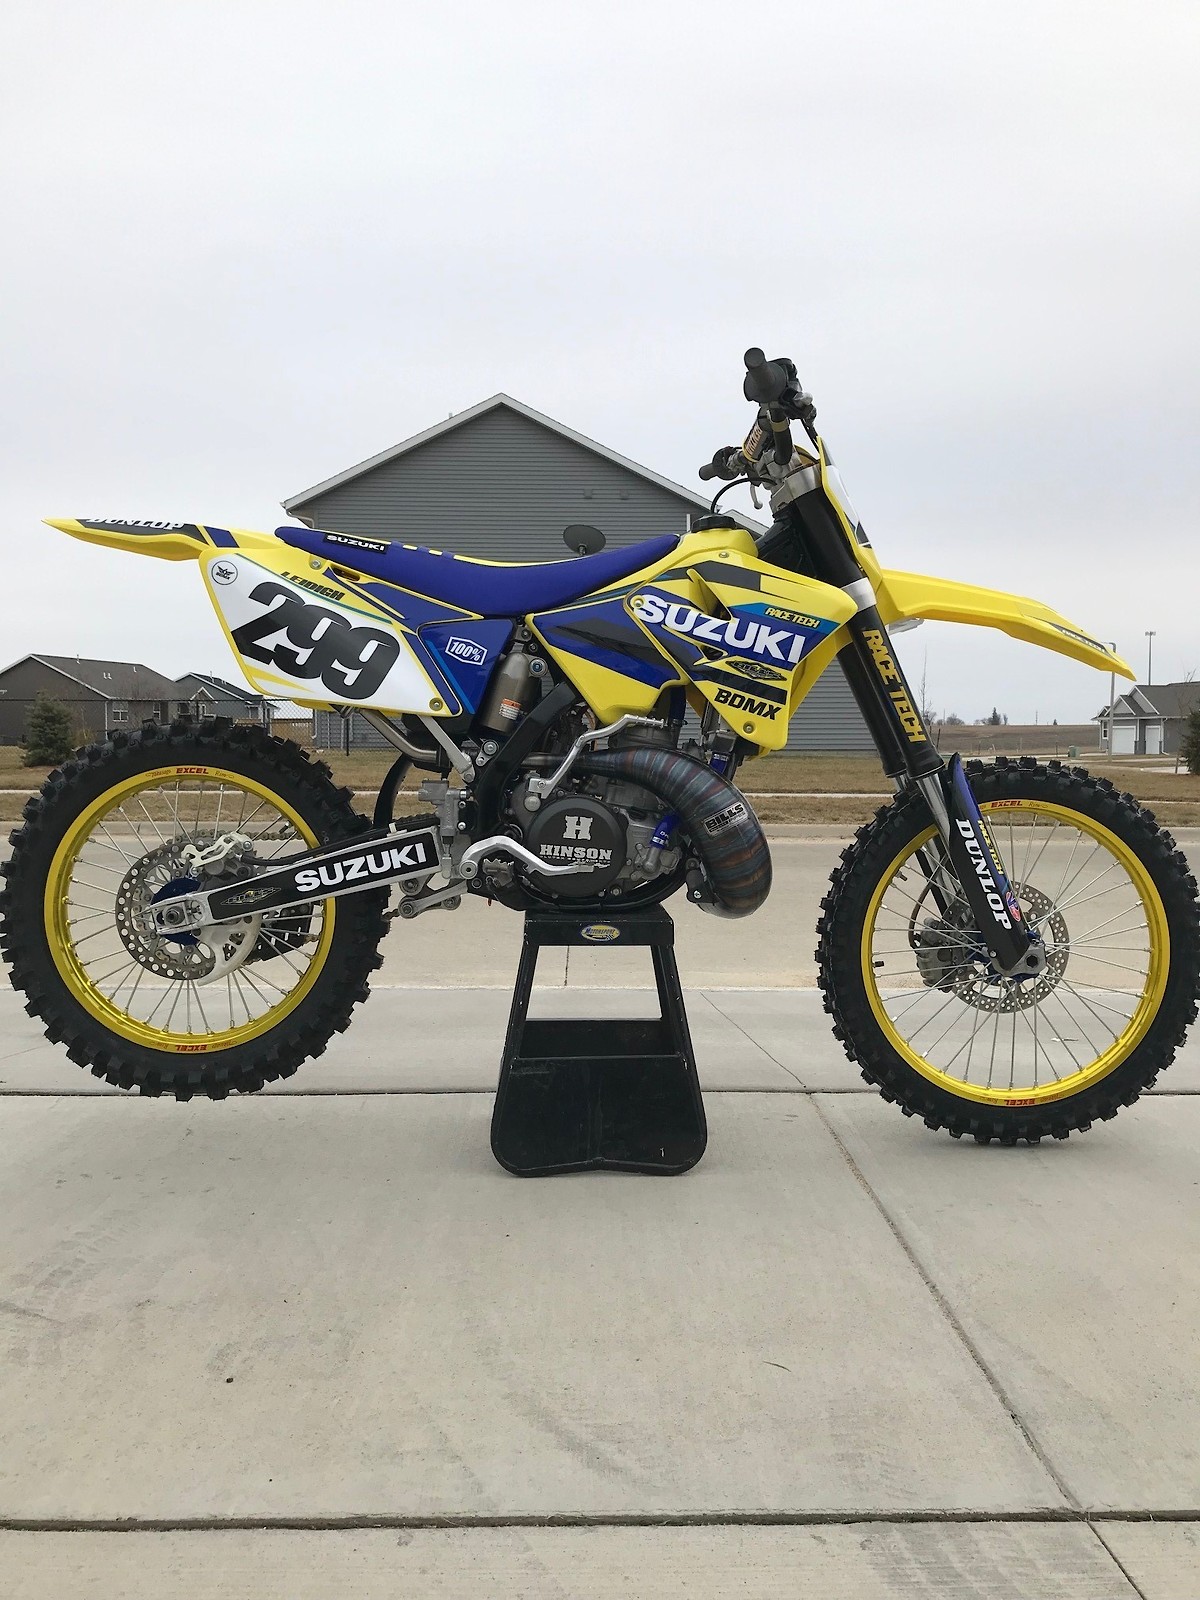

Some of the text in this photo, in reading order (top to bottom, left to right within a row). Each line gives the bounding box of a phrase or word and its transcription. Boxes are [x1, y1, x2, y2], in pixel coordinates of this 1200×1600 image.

[326, 534, 386, 551] SUZUKI
[633, 594, 806, 663] SUZUKI
[765, 607, 821, 628] RACE TECH
[231, 581, 401, 700] 299
[450, 641, 482, 662] 100%
[862, 629, 927, 742] RACE TECH
[713, 688, 783, 720] BDMX
[176, 767, 209, 775] EXCEL
[990, 800, 1023, 808] EXCEL
[563, 815, 593, 840] H
[540, 844, 613, 860] HINSON
[294, 842, 427, 892] SUZUKI
[955, 818, 1013, 930] DUNLOP
